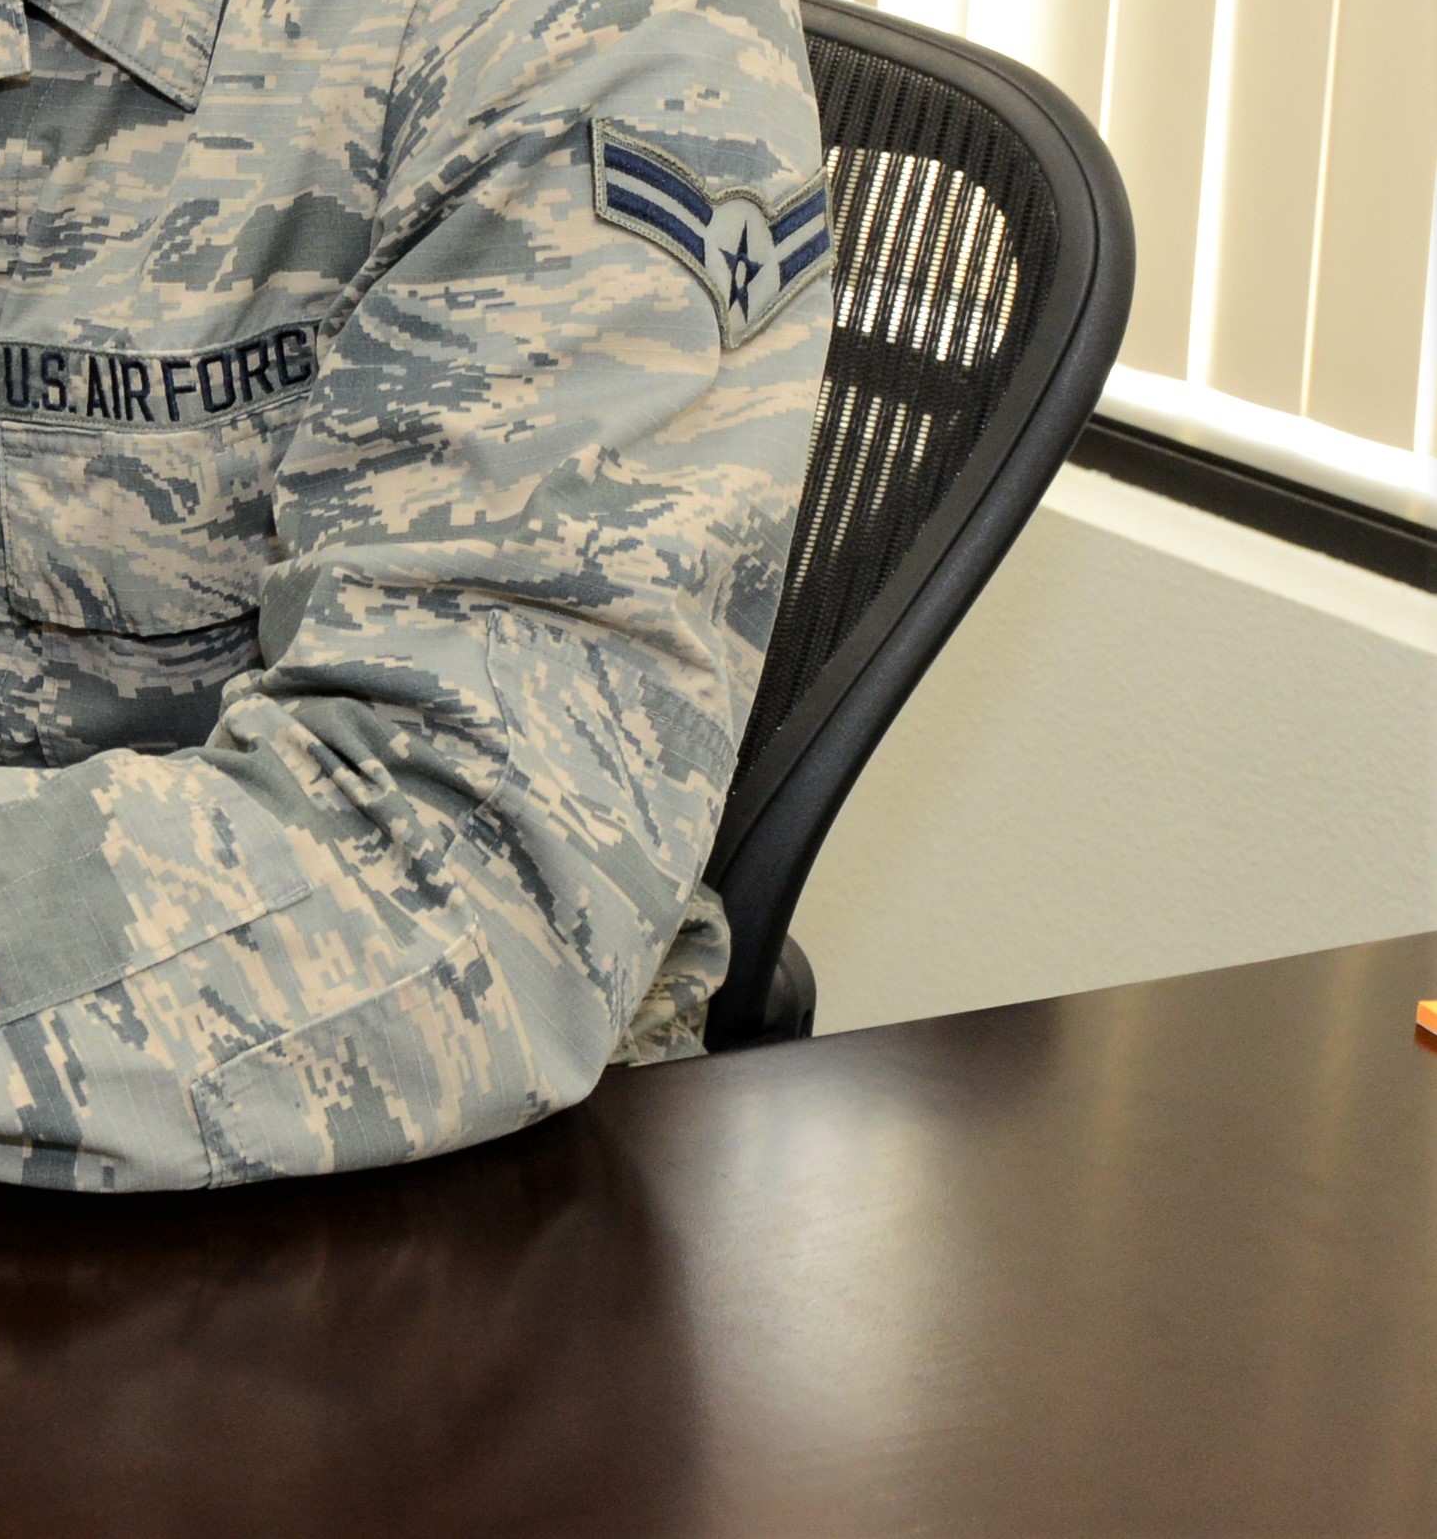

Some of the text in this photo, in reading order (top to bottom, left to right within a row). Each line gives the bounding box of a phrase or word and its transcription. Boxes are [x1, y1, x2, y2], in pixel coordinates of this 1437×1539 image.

[2, 323, 320, 423] U.S. AIR FORC
